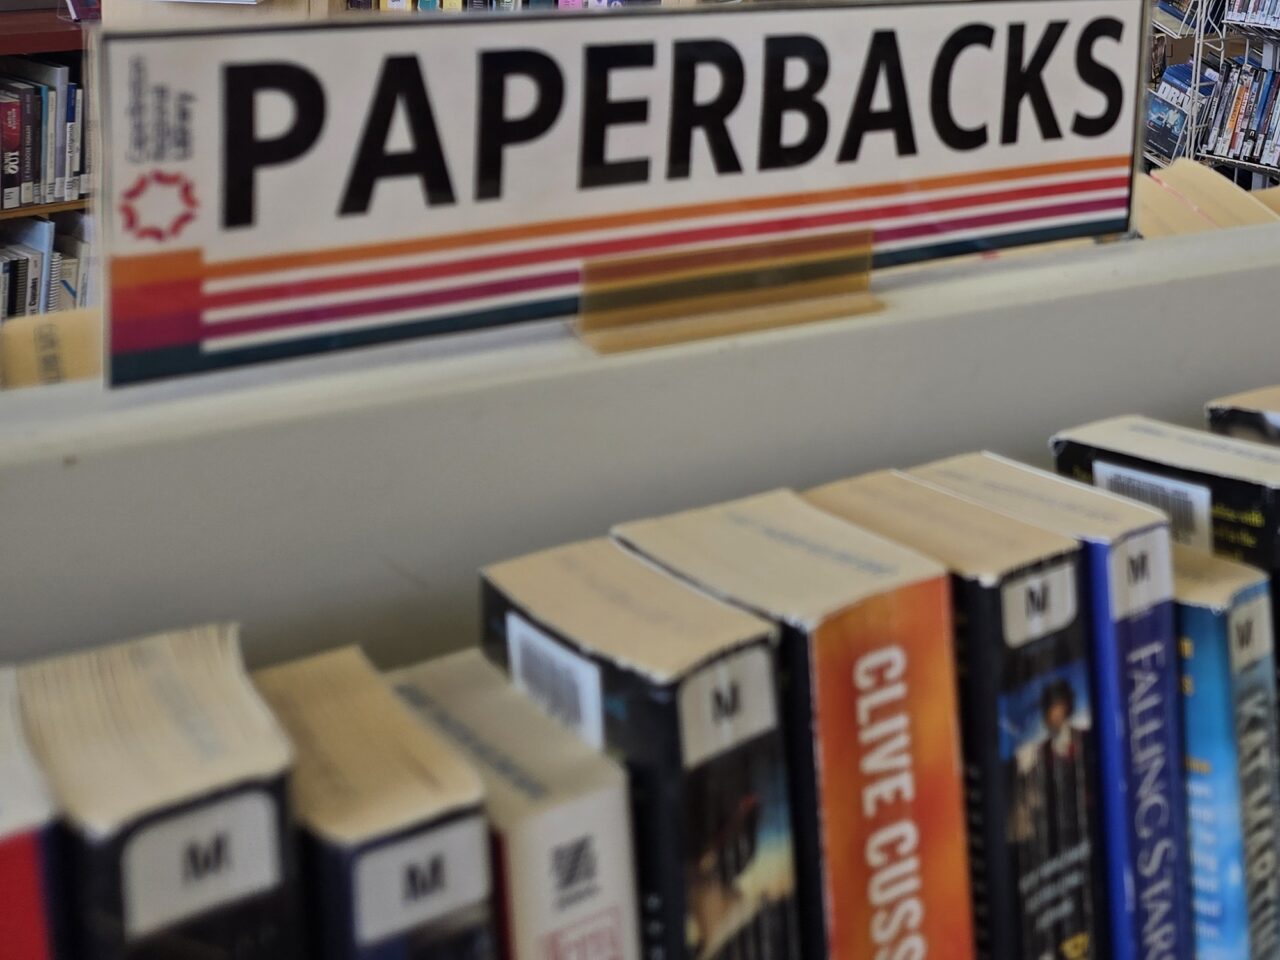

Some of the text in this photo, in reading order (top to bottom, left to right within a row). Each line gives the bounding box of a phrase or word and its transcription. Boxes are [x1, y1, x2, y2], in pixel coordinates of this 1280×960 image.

[220, 14, 1127, 230] PAPERBACKS
[853, 644, 917, 818] CLIVE
[1127, 640, 1170, 838] FALLING
[1237, 690, 1271, 770] KAT
[182, 837, 230, 882] M
[404, 854, 445, 899] M
